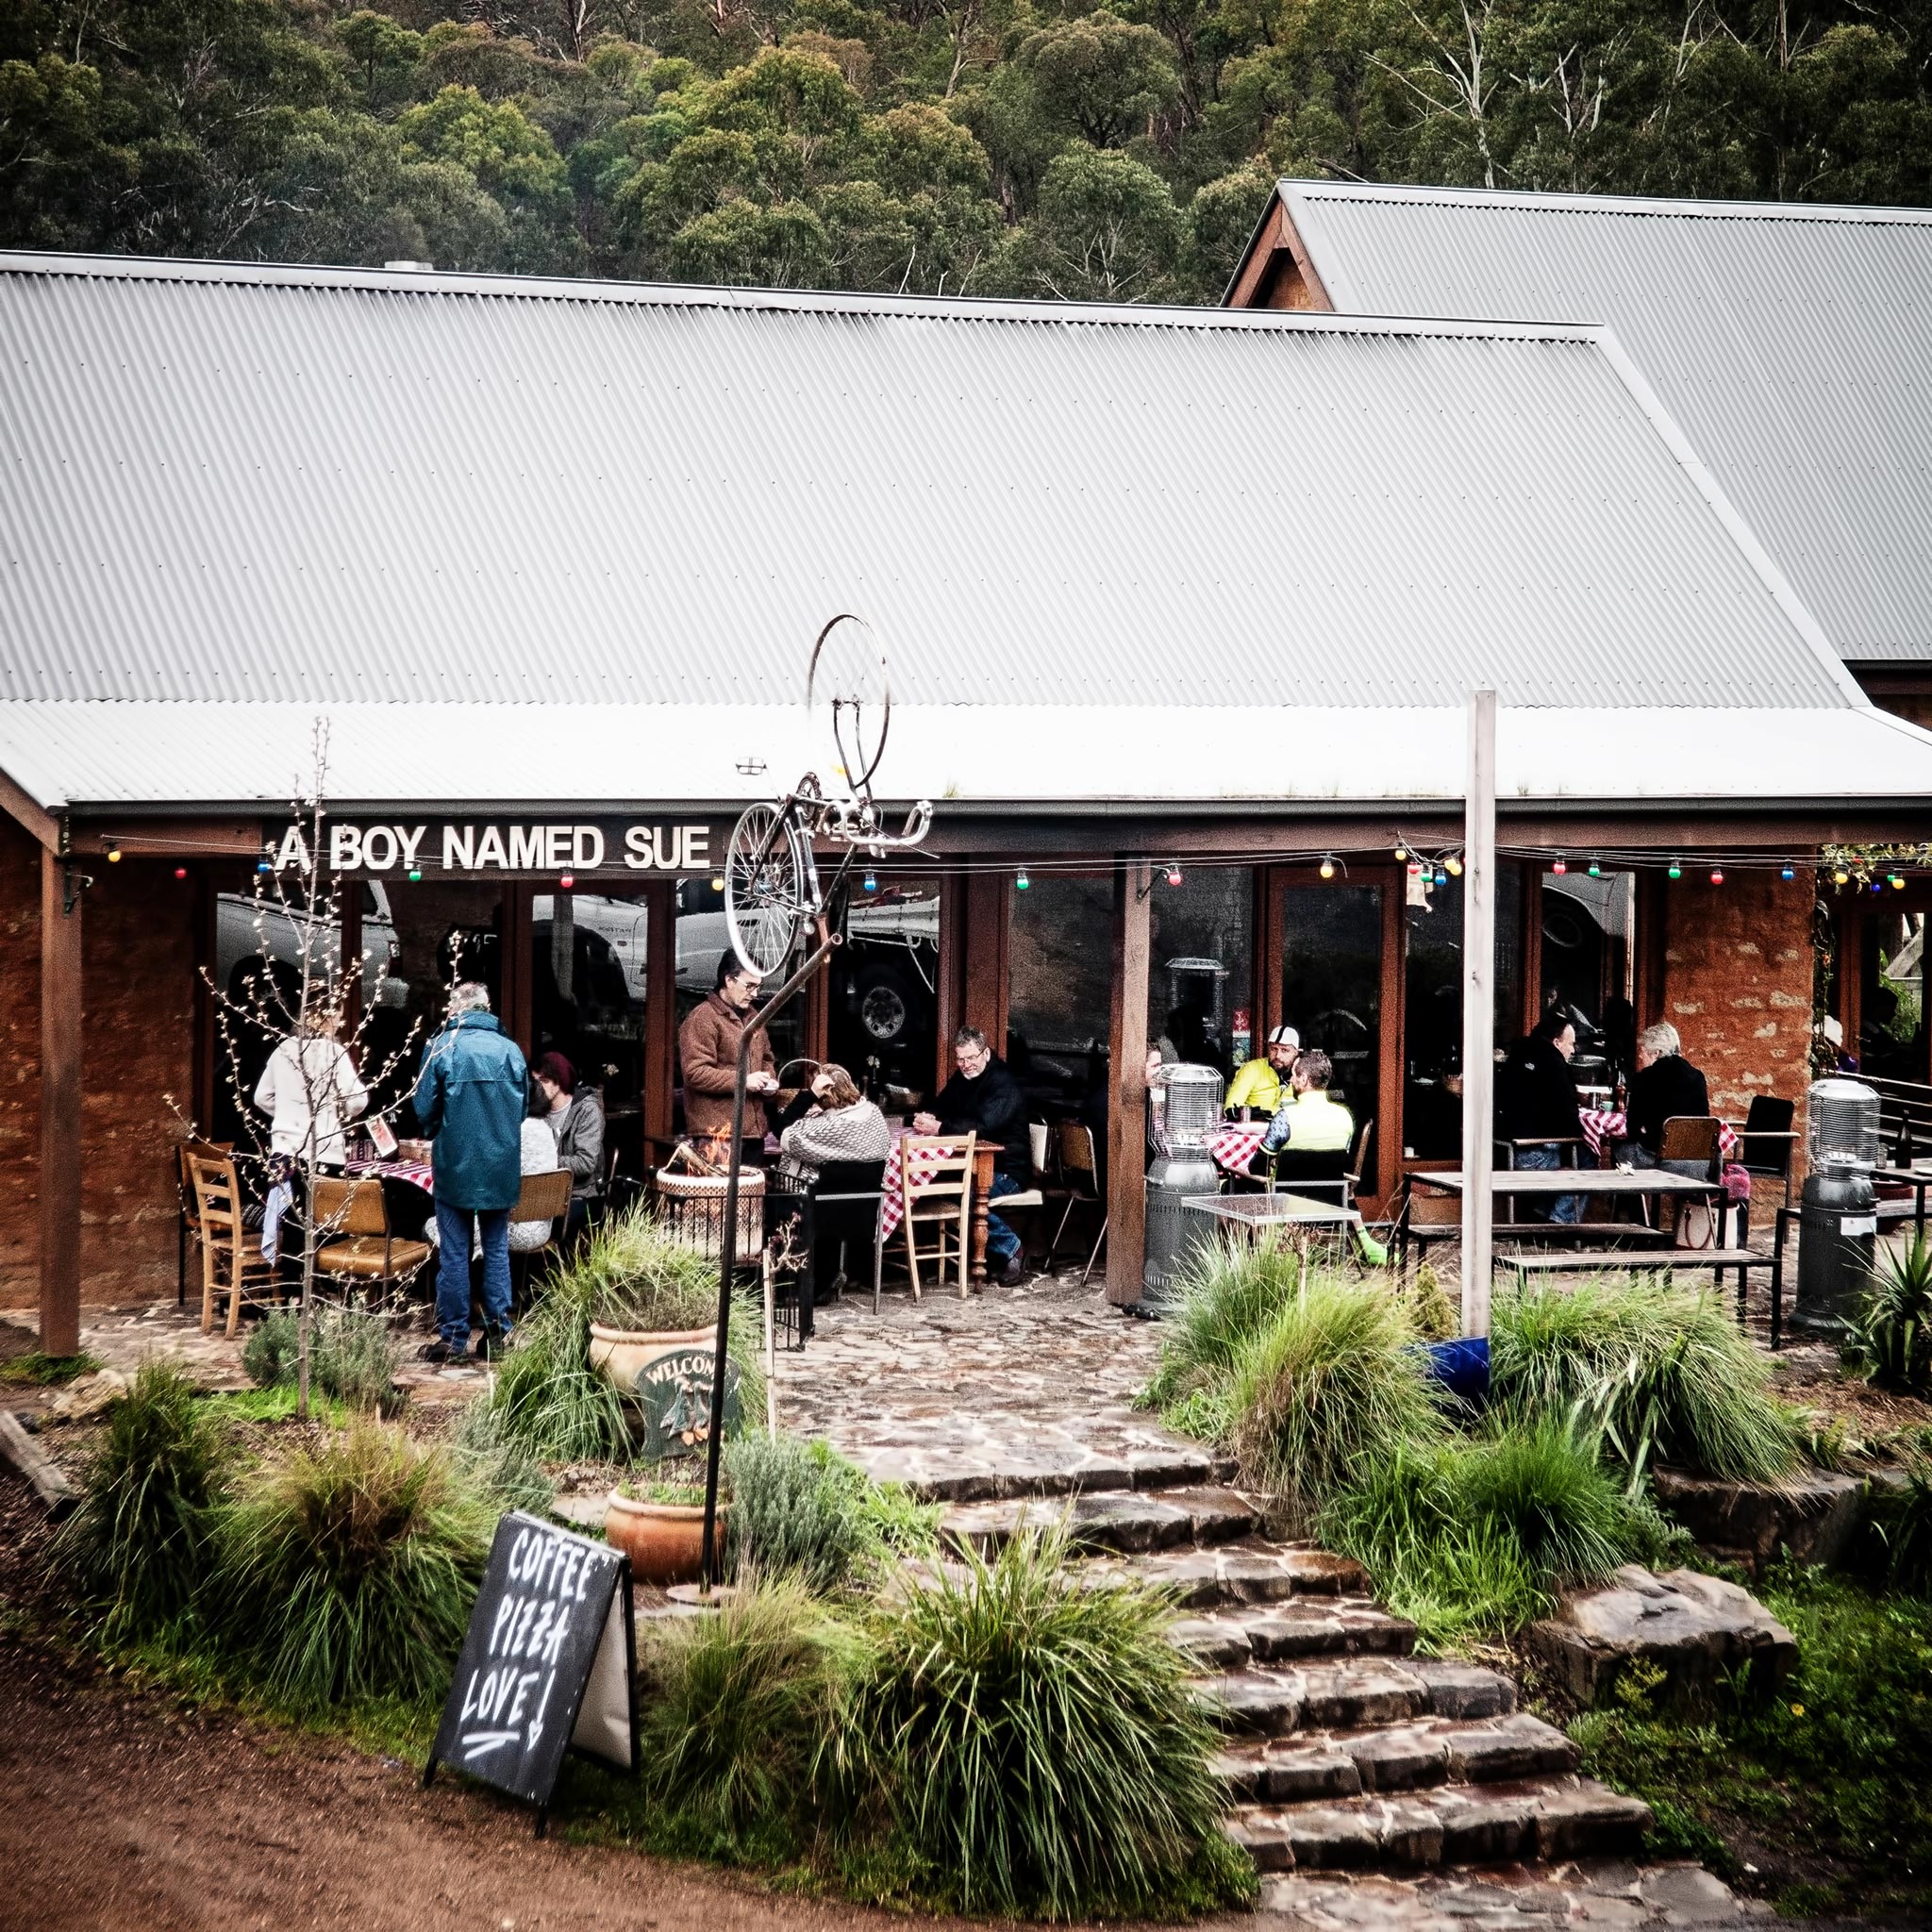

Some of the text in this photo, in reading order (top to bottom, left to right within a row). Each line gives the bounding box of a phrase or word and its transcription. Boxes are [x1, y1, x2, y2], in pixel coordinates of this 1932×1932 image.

[275, 825, 710, 870] A BOY NAMED SUE
[645, 1356, 731, 1386] WELCOM
[508, 1526, 596, 1603] COFFEE
[489, 1592, 569, 1666] PIZZA
